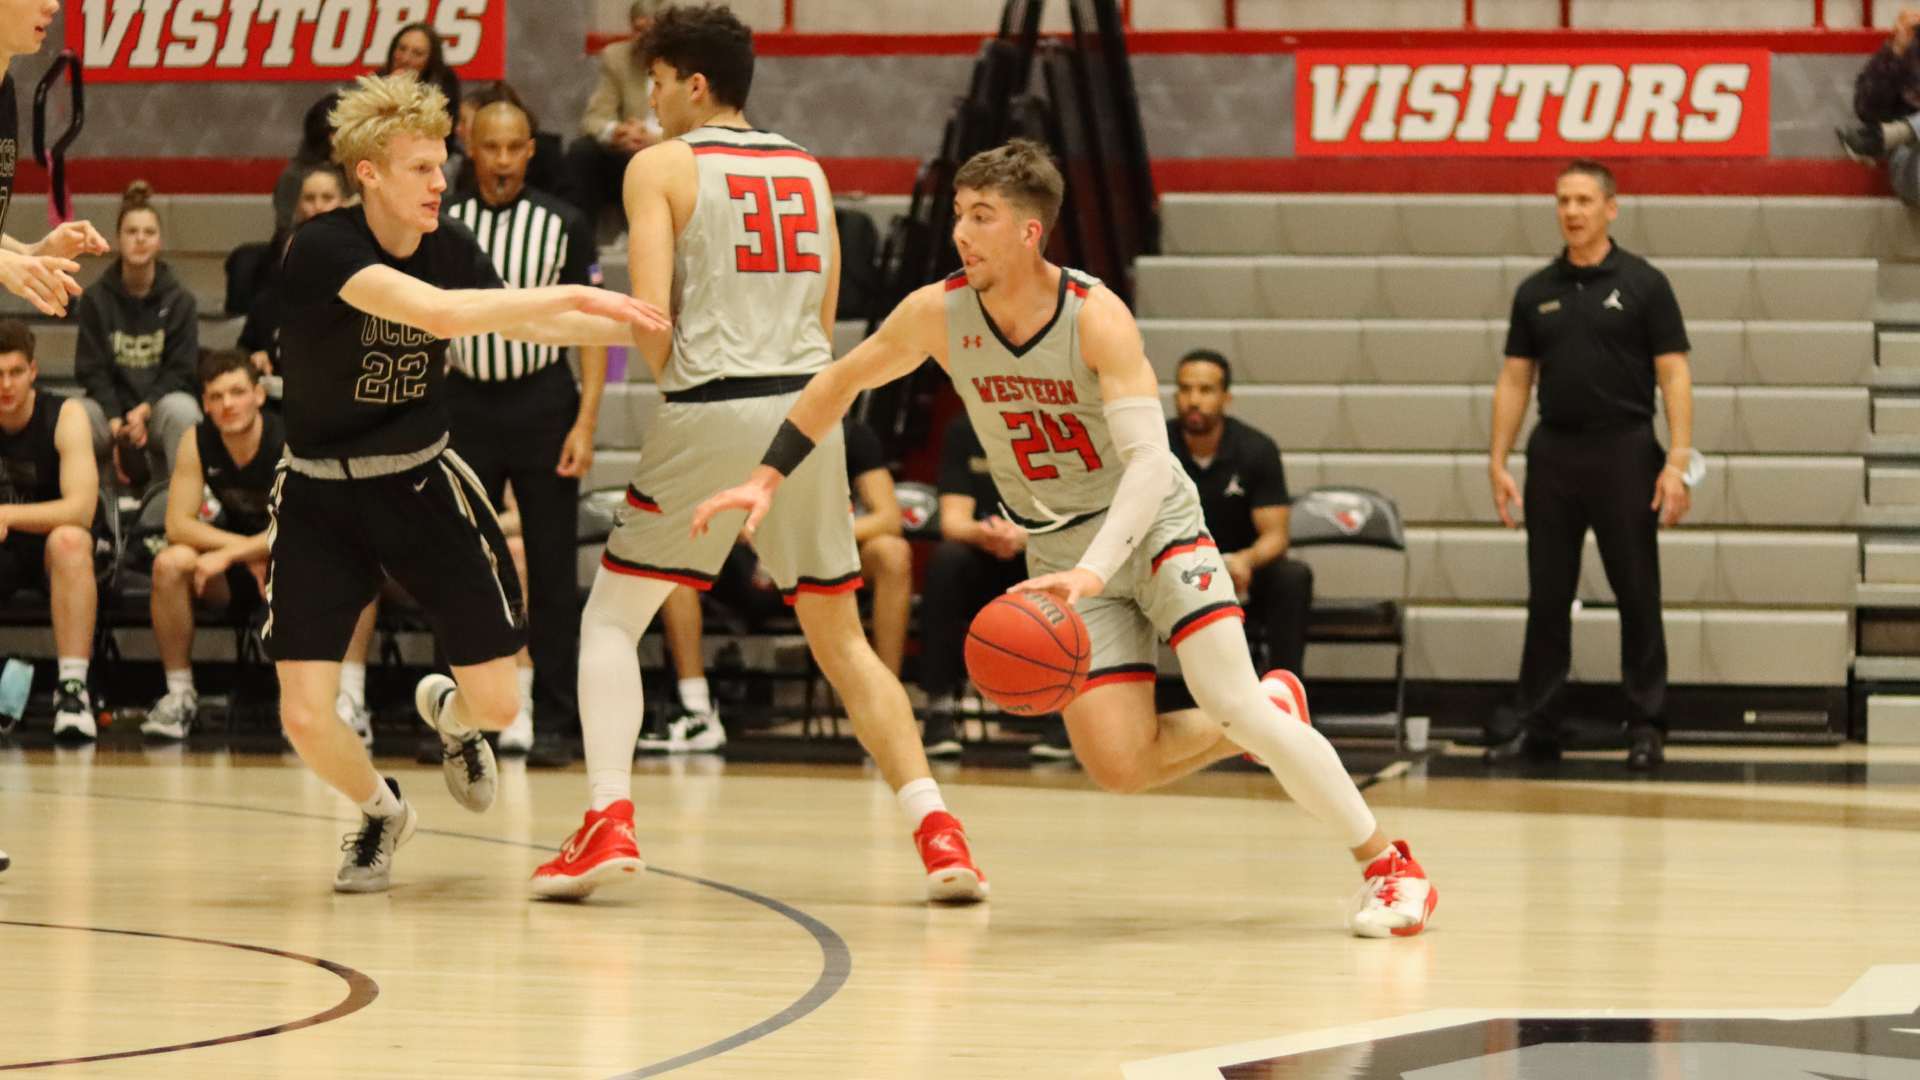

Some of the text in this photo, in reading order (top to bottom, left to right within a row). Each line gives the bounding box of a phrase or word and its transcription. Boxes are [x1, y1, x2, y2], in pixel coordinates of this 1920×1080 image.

[1309, 63, 1751, 143] VISITORS
[725, 173, 821, 273] 32
[354, 351, 429, 404] 22
[971, 375, 1078, 406] WESTERN
[1000, 409, 1104, 482] 24
